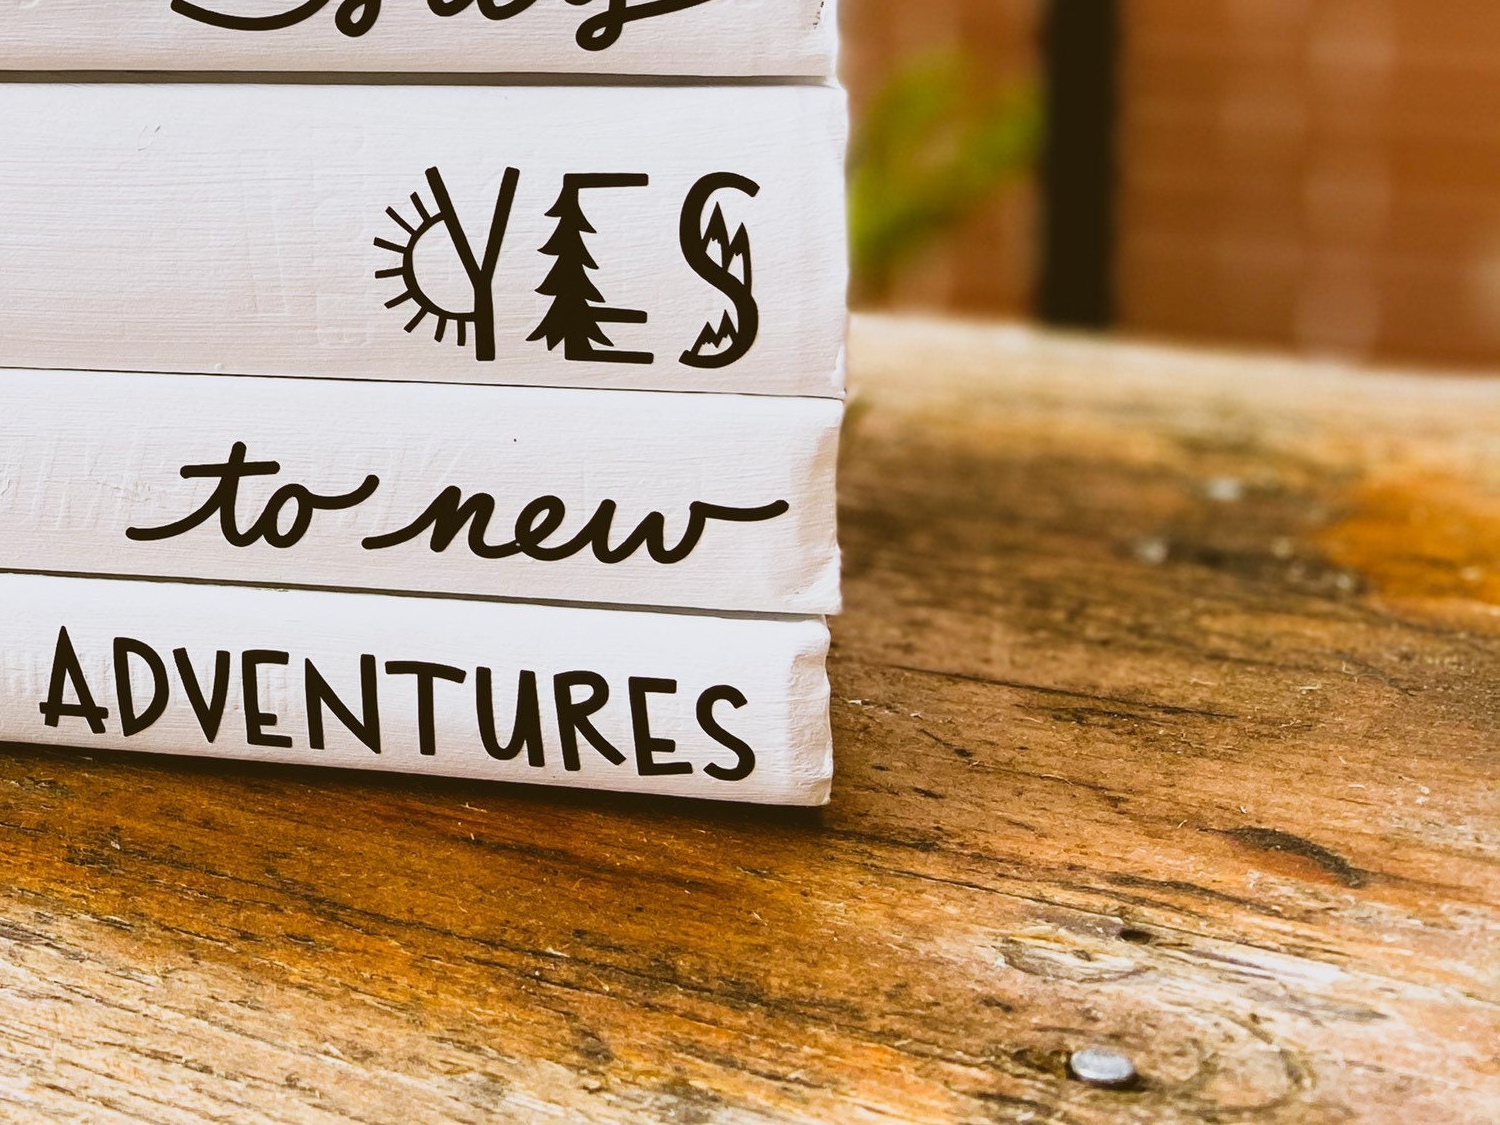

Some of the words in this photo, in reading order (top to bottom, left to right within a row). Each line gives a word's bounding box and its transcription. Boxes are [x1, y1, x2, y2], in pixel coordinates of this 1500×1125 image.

[374, 167, 760, 368] YES
[126, 442, 382, 549] to
[362, 486, 789, 564] new
[40, 626, 755, 781] ADVENTURES
